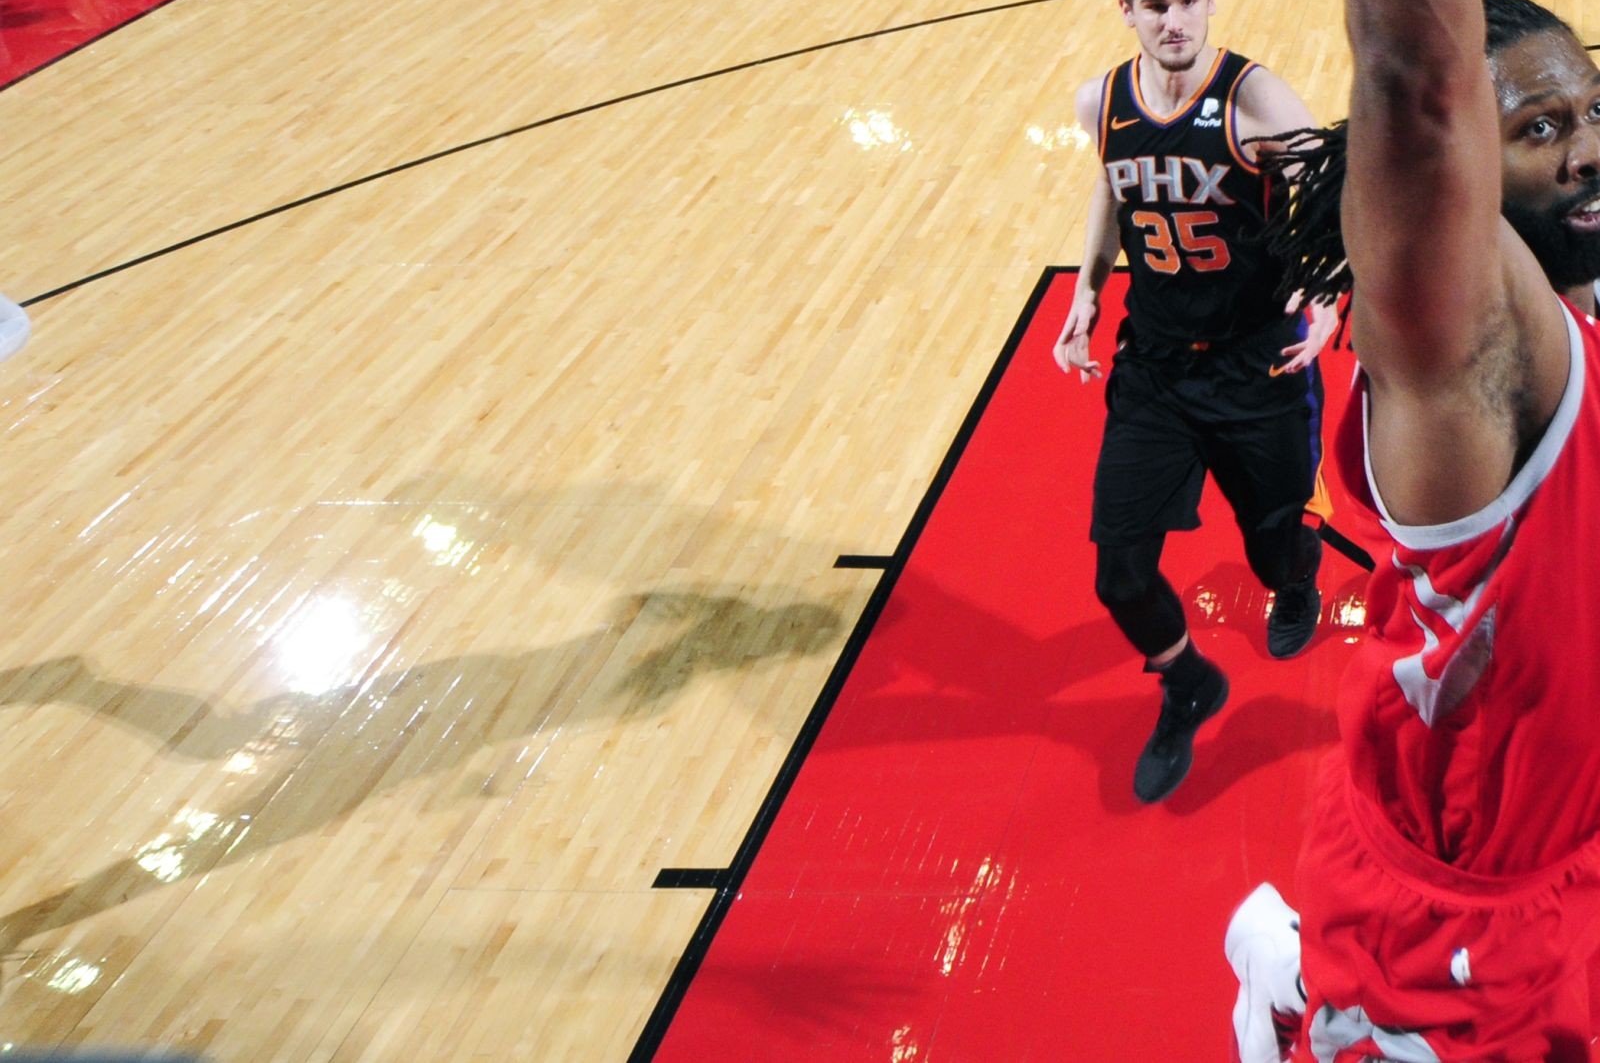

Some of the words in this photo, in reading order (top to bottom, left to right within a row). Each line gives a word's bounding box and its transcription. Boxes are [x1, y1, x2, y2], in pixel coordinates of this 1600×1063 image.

[1193, 118, 1222, 128] PayPal
[1105, 155, 1236, 205] PHX
[1131, 210, 1231, 275] 35
